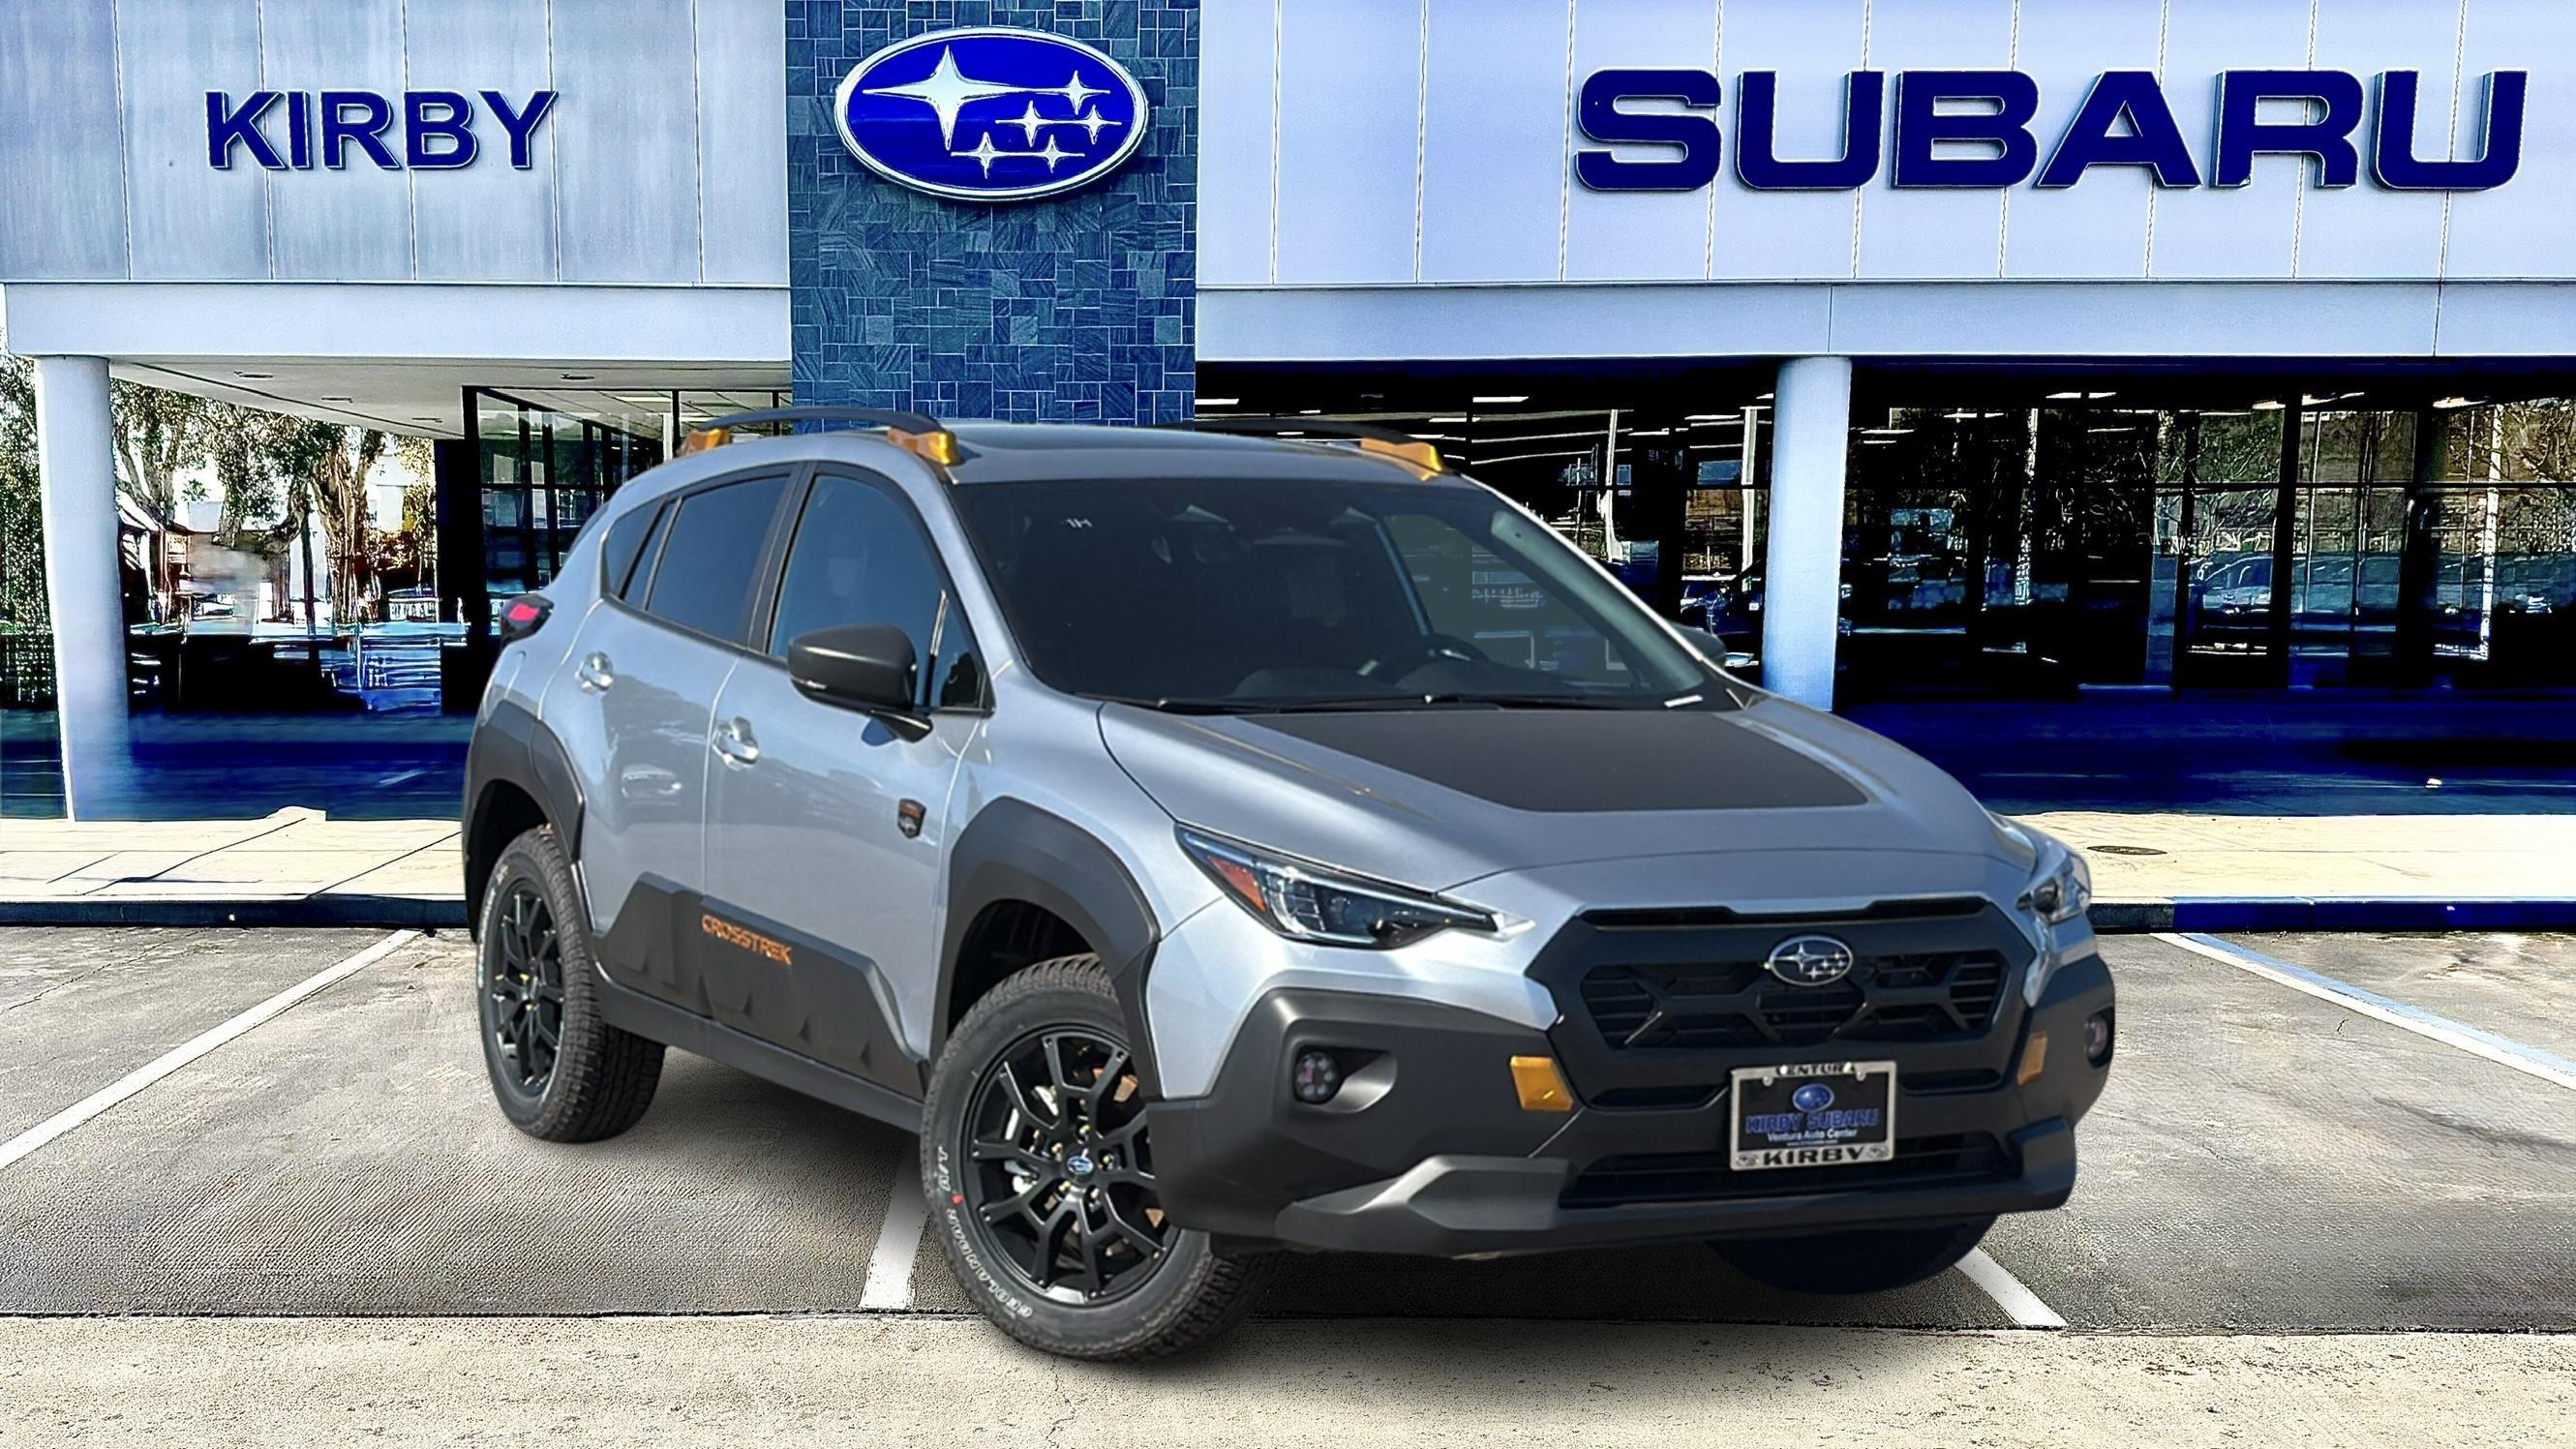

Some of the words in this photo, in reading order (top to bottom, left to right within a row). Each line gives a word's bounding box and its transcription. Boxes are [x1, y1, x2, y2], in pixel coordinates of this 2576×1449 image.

[204, 90, 559, 169] KIRBY
[1574, 69, 2528, 191] SUBARU
[702, 914, 792, 965] CROSSTREK
[1746, 1113, 1803, 1133] KIRBY
[1807, 1109, 1878, 1130] SUBARU
[1768, 1132, 1802, 1142] Ventura
[1803, 1130, 1825, 1139] Auto
[1827, 1129, 1858, 1138] Center
[1763, 1146, 1864, 1165] KIRBY
[947, 1208, 1033, 1317] GEOLANDAR
